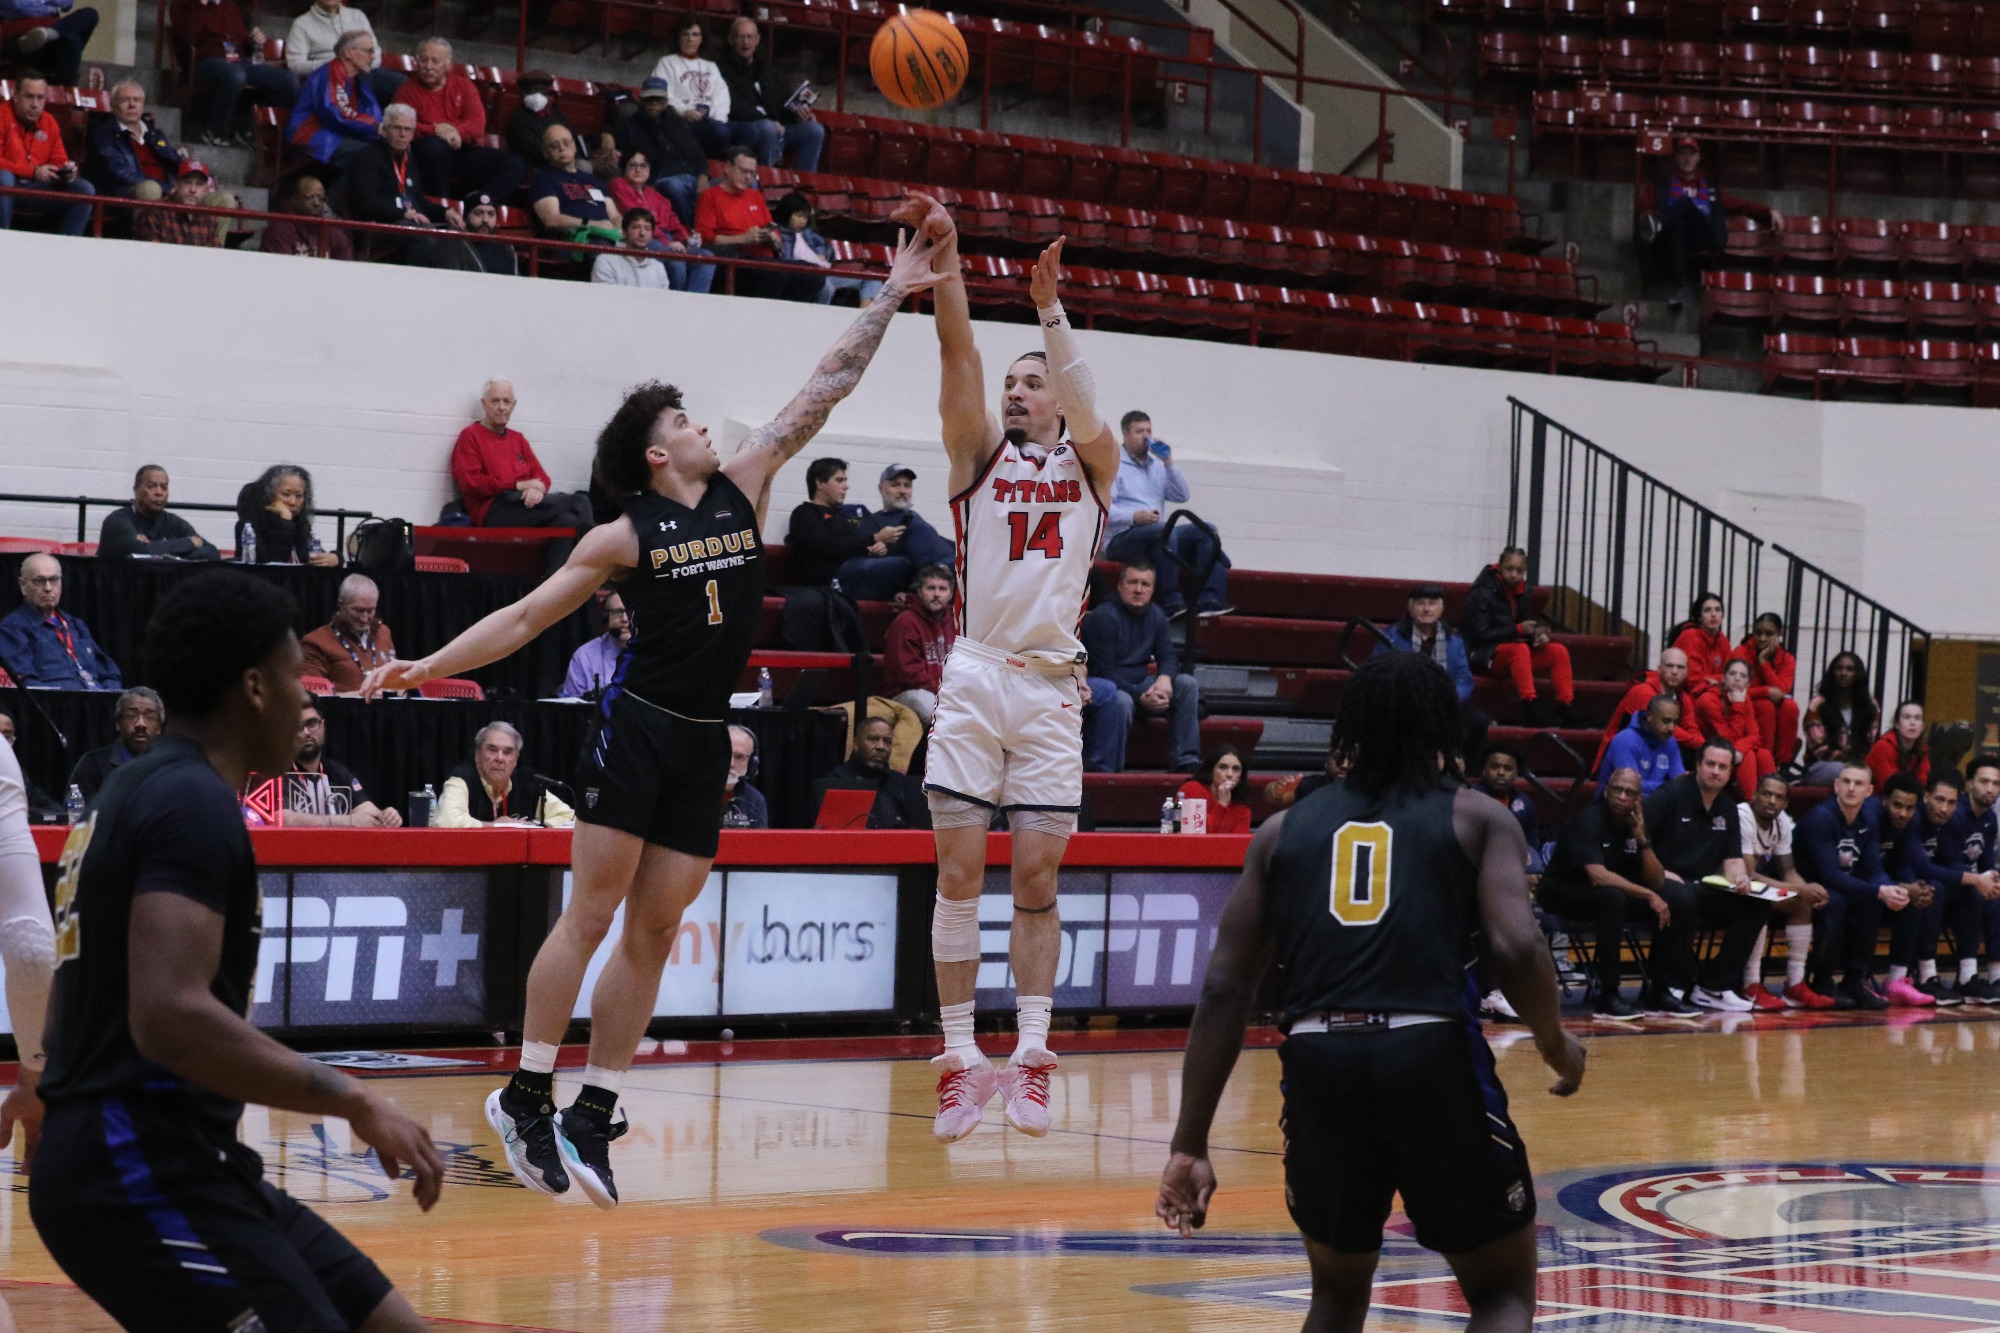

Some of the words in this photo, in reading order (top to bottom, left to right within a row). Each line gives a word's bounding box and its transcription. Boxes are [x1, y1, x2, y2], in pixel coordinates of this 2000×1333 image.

[992, 477, 1082, 503] TITANS
[650, 528, 756, 570] PURDUE
[1008, 511, 1063, 561] 14
[671, 563, 705, 579] FORT
[706, 555, 745, 572] WAYNE
[705, 579, 723, 625] 1
[1329, 820, 1393, 926] 0
[747, 904, 875, 964] bars
